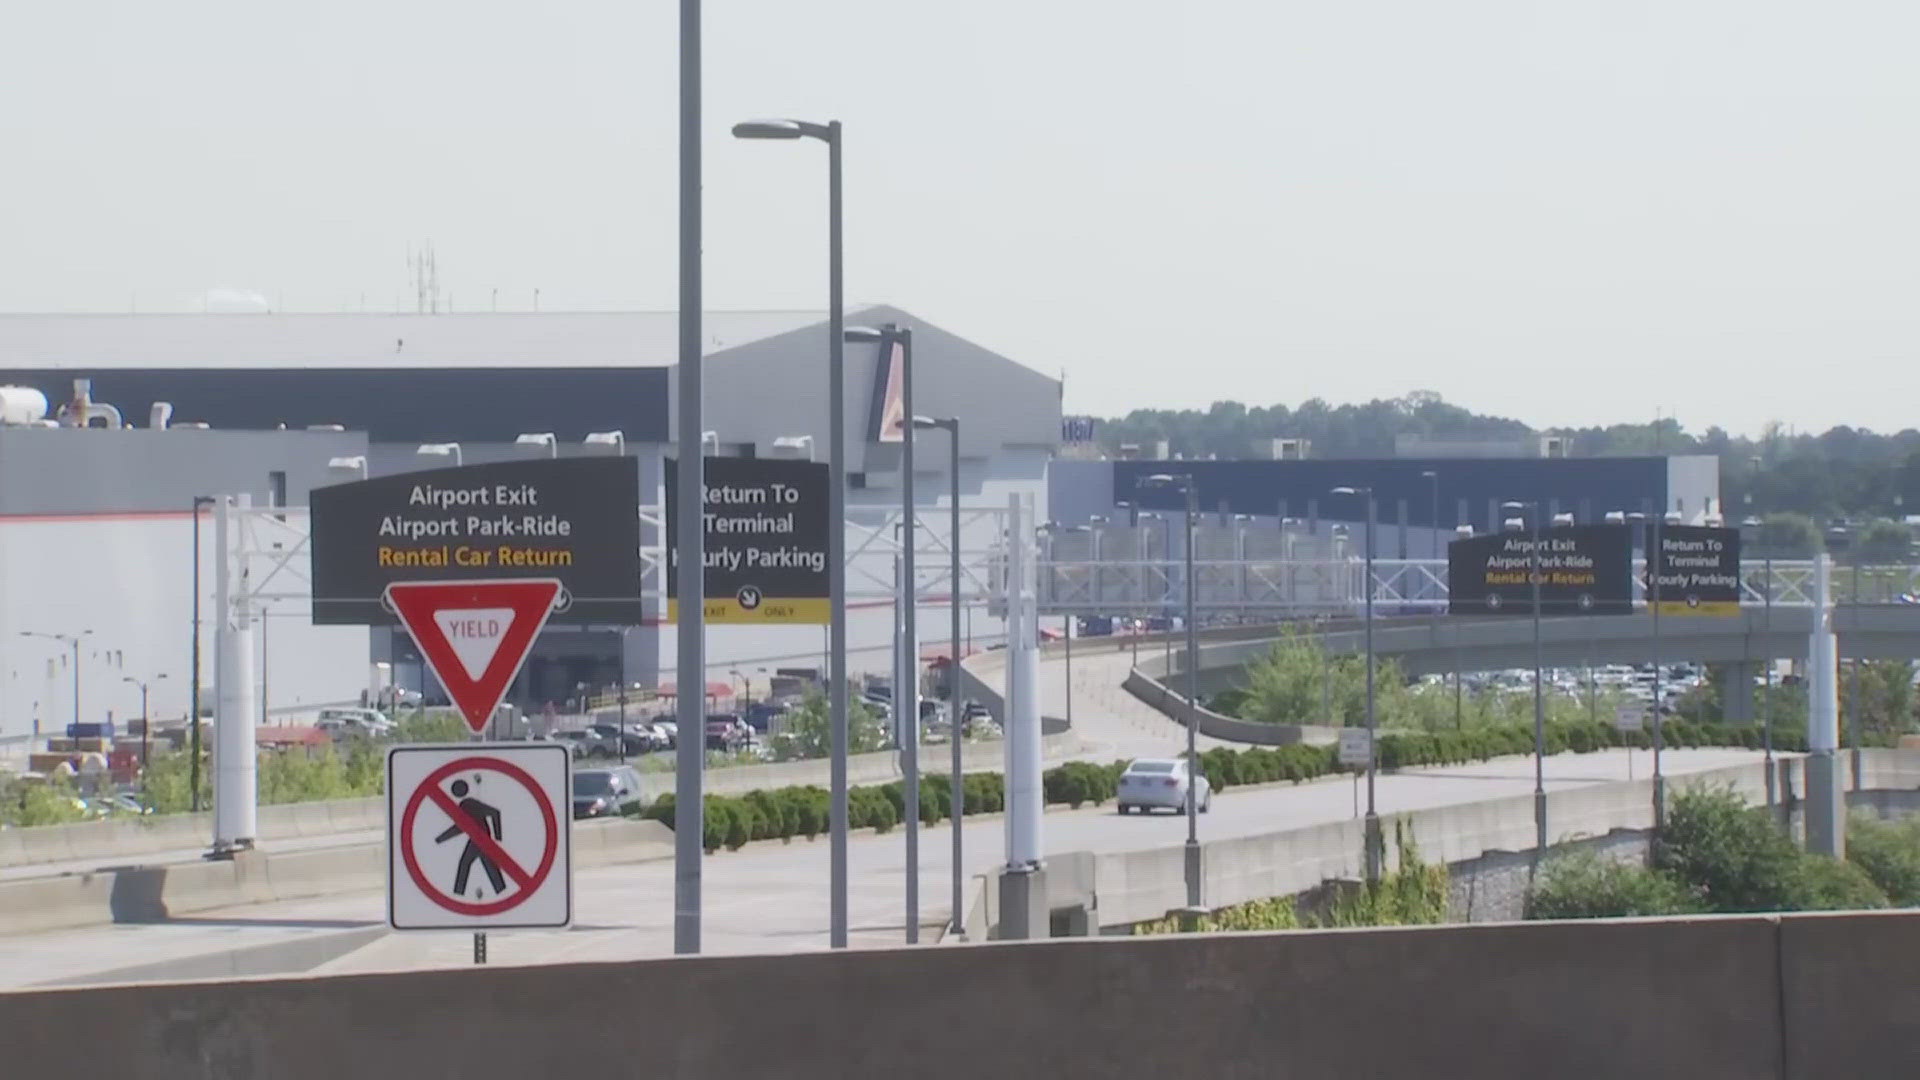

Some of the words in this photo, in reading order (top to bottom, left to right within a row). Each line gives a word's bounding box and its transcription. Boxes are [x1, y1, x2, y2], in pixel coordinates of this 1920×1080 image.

[409, 484, 489, 510] Airport
[495, 484, 538, 505] Exit
[771, 484, 799, 504] To
[379, 516, 459, 541] Airport
[467, 515, 571, 536] Park-Ride
[704, 512, 794, 533] Terminal
[1552, 538, 1575, 551] Exit
[1663, 539, 1704, 551] Return
[1706, 539, 1723, 551] To
[378, 546, 449, 566] Rental
[455, 546, 491, 566] Car
[498, 546, 572, 566] Return
[672, 546, 741, 572] urly
[746, 546, 825, 572] Parking
[1487, 555, 1531, 570] Airport
[1667, 554, 1719, 567] Terminal
[1487, 572, 1526, 584] Rental
[1552, 572, 1595, 584] Return
[1691, 573, 1737, 589] Parking
[764, 606, 794, 618] ONLY
[450, 619, 499, 638] YIELD
